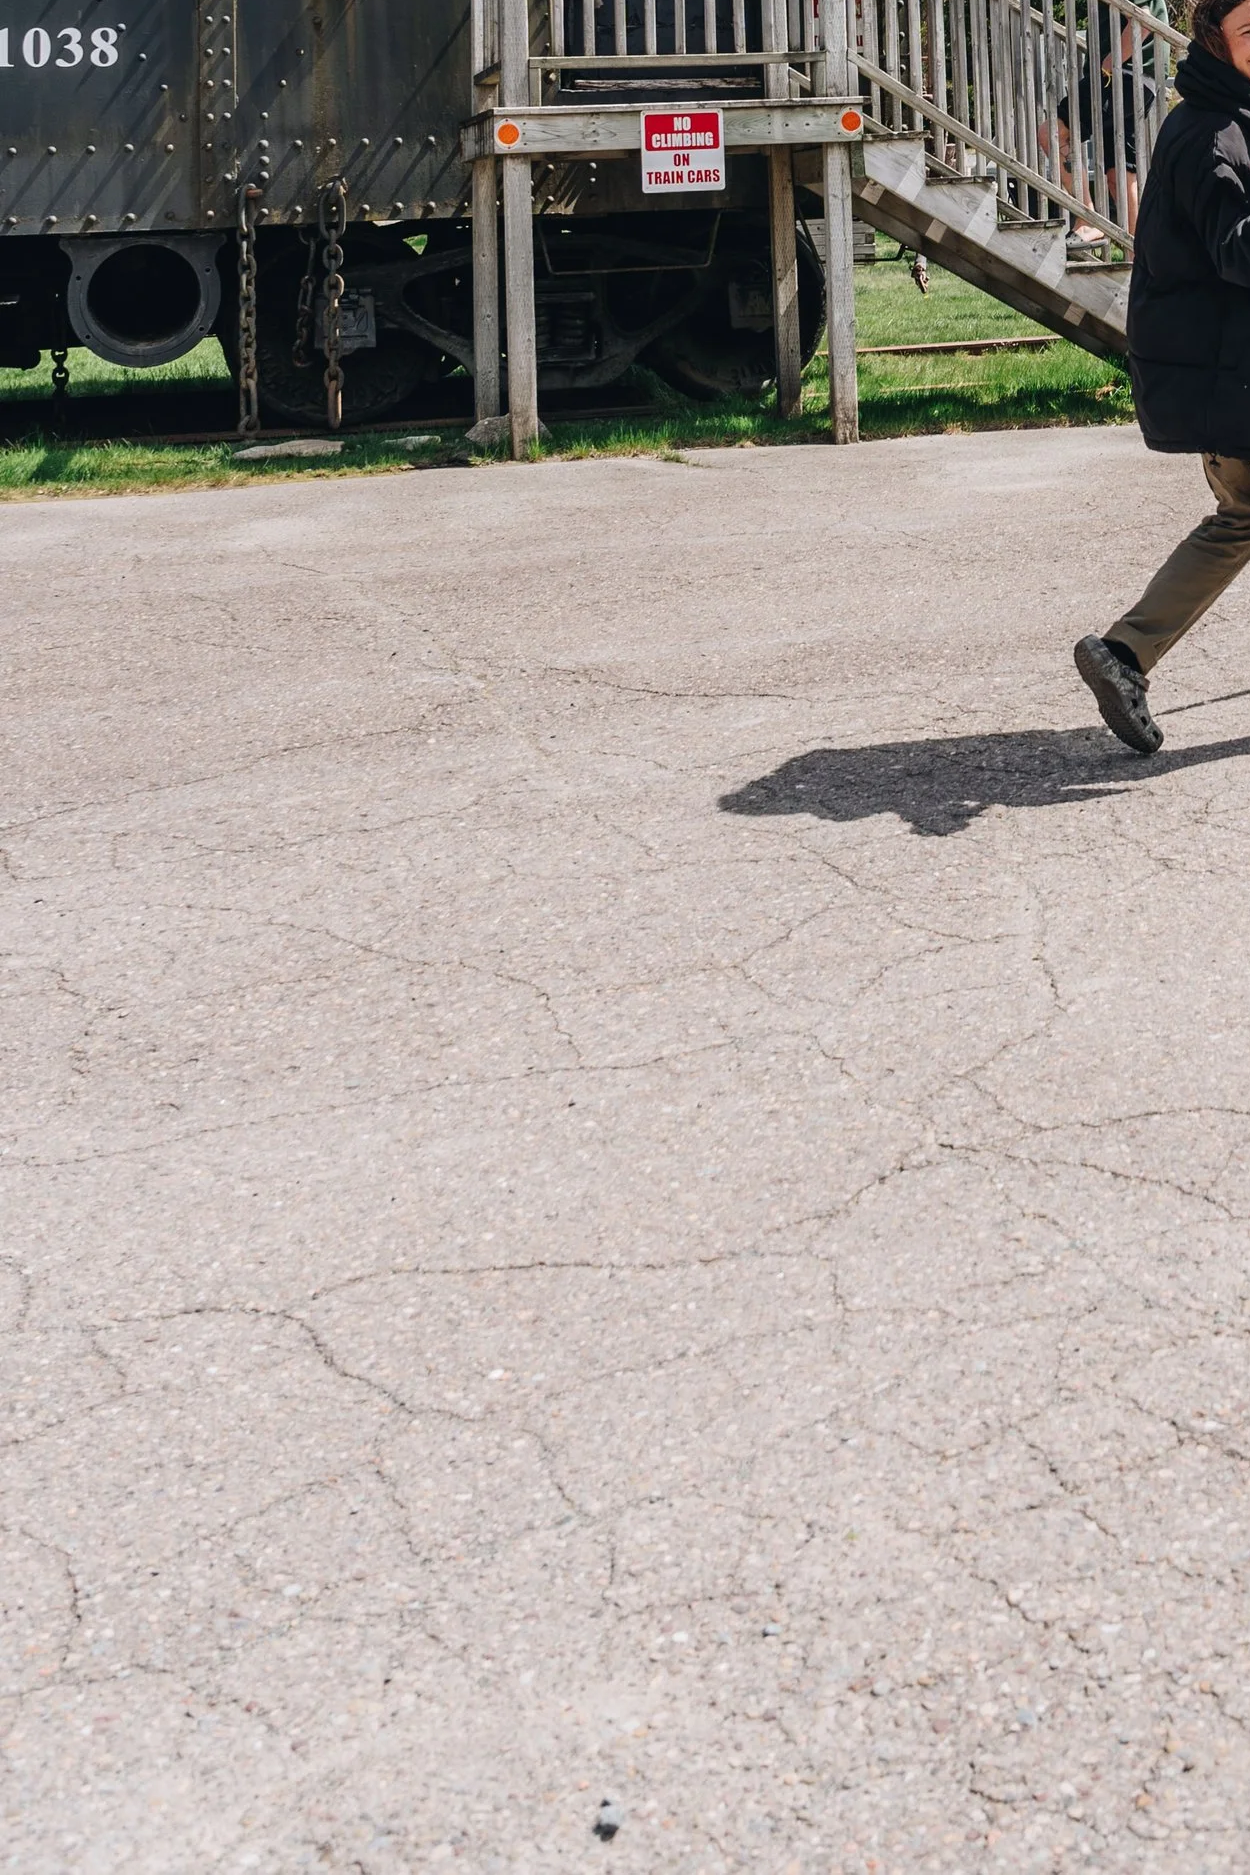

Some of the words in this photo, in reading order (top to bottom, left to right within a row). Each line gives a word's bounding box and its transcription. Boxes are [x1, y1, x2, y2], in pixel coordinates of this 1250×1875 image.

[673, 116, 691, 131] NO
[651, 132, 714, 148] CLIMBING
[673, 153, 690, 166] ON
[646, 171, 683, 185] TRAIN
[687, 169, 720, 183] CARS
